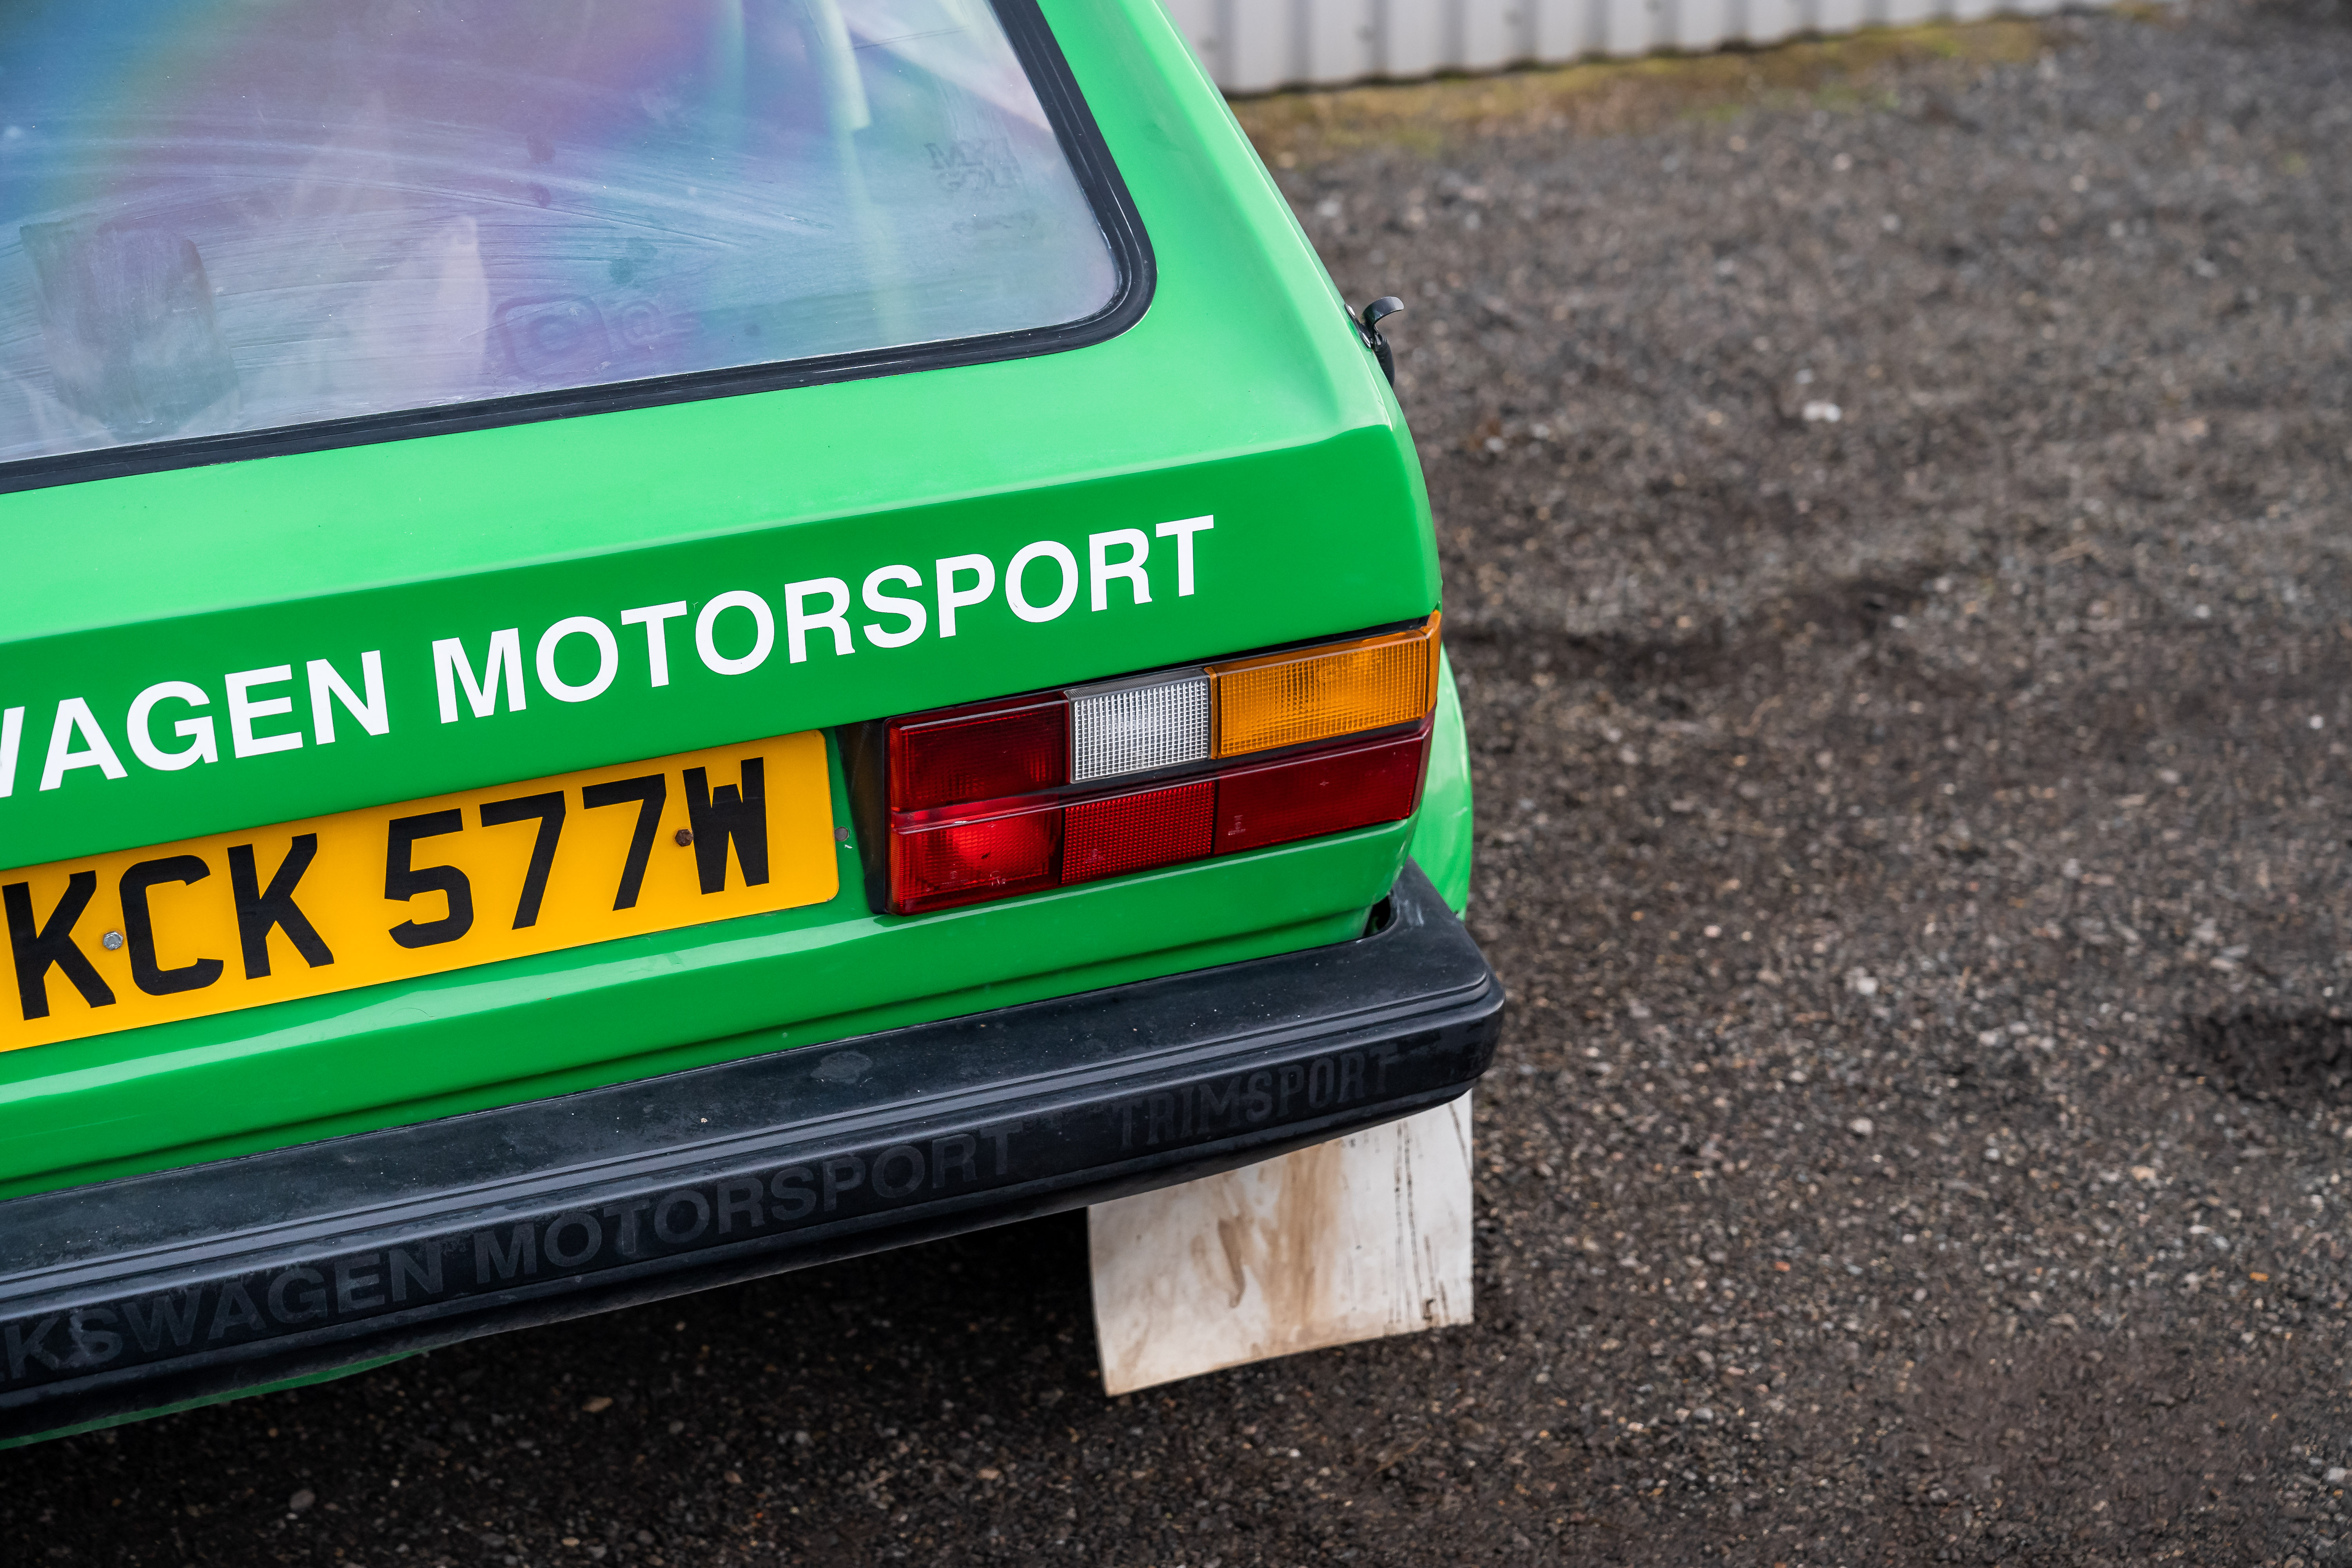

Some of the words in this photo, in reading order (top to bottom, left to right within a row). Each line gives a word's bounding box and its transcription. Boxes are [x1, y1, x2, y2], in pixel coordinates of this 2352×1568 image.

[0, 650, 390, 798] AGEN
[432, 514, 1214, 724] MOTORSPORT
[1, 869, 335, 1021] KCK
[384, 756, 770, 949] 577W
[0, 1249, 443, 1381] KSWAGEN
[473, 1125, 1022, 1284] MOTORSPORT
